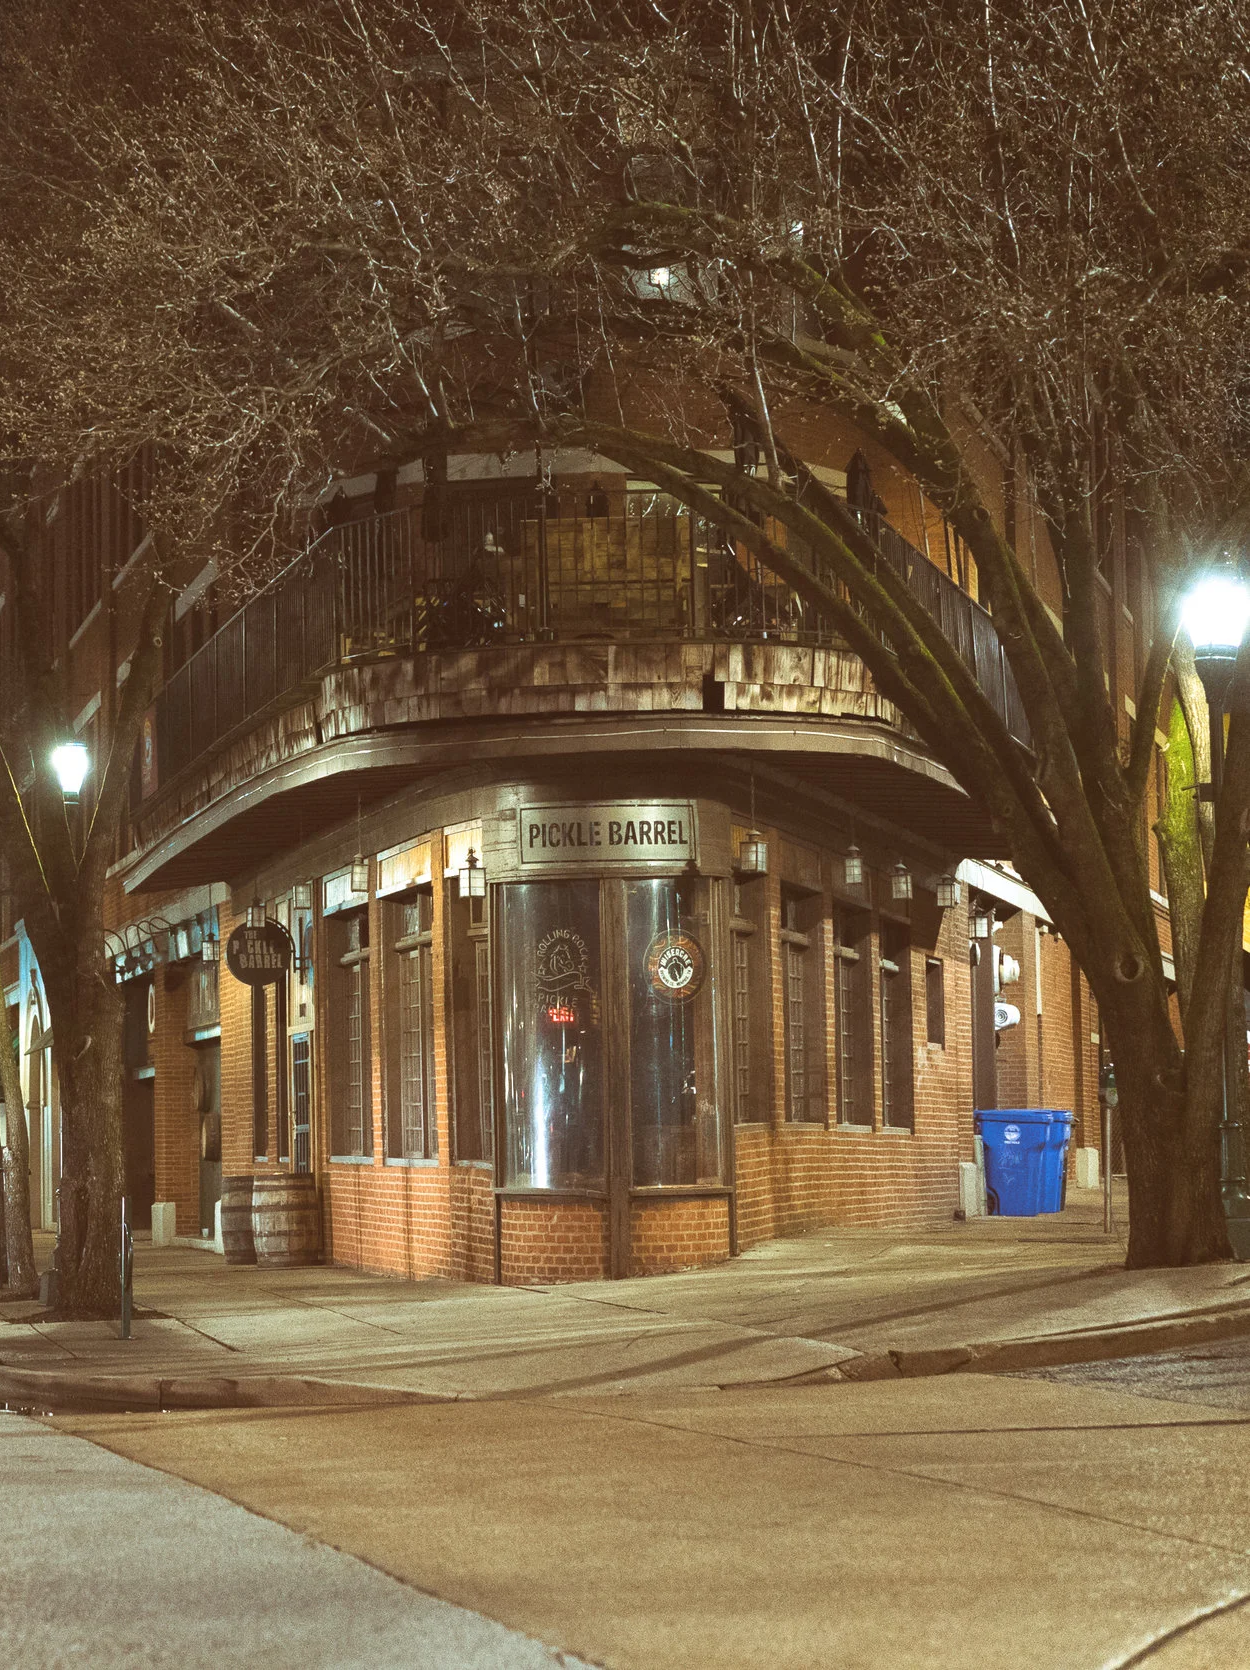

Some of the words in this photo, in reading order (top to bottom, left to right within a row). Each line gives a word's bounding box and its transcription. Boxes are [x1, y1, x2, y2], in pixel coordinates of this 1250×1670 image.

[528, 821, 601, 848] PICKLE
[608, 819, 689, 846] BARREL
[243, 930, 257, 940] THE
[232, 939, 275, 955] PCKL
[537, 929, 571, 957] ROLLING
[572, 934, 589, 961] ROCK
[239, 953, 283, 969] BARREL
[659, 948, 692, 967] WISEACRE
[537, 993, 579, 1008] PICKLE
